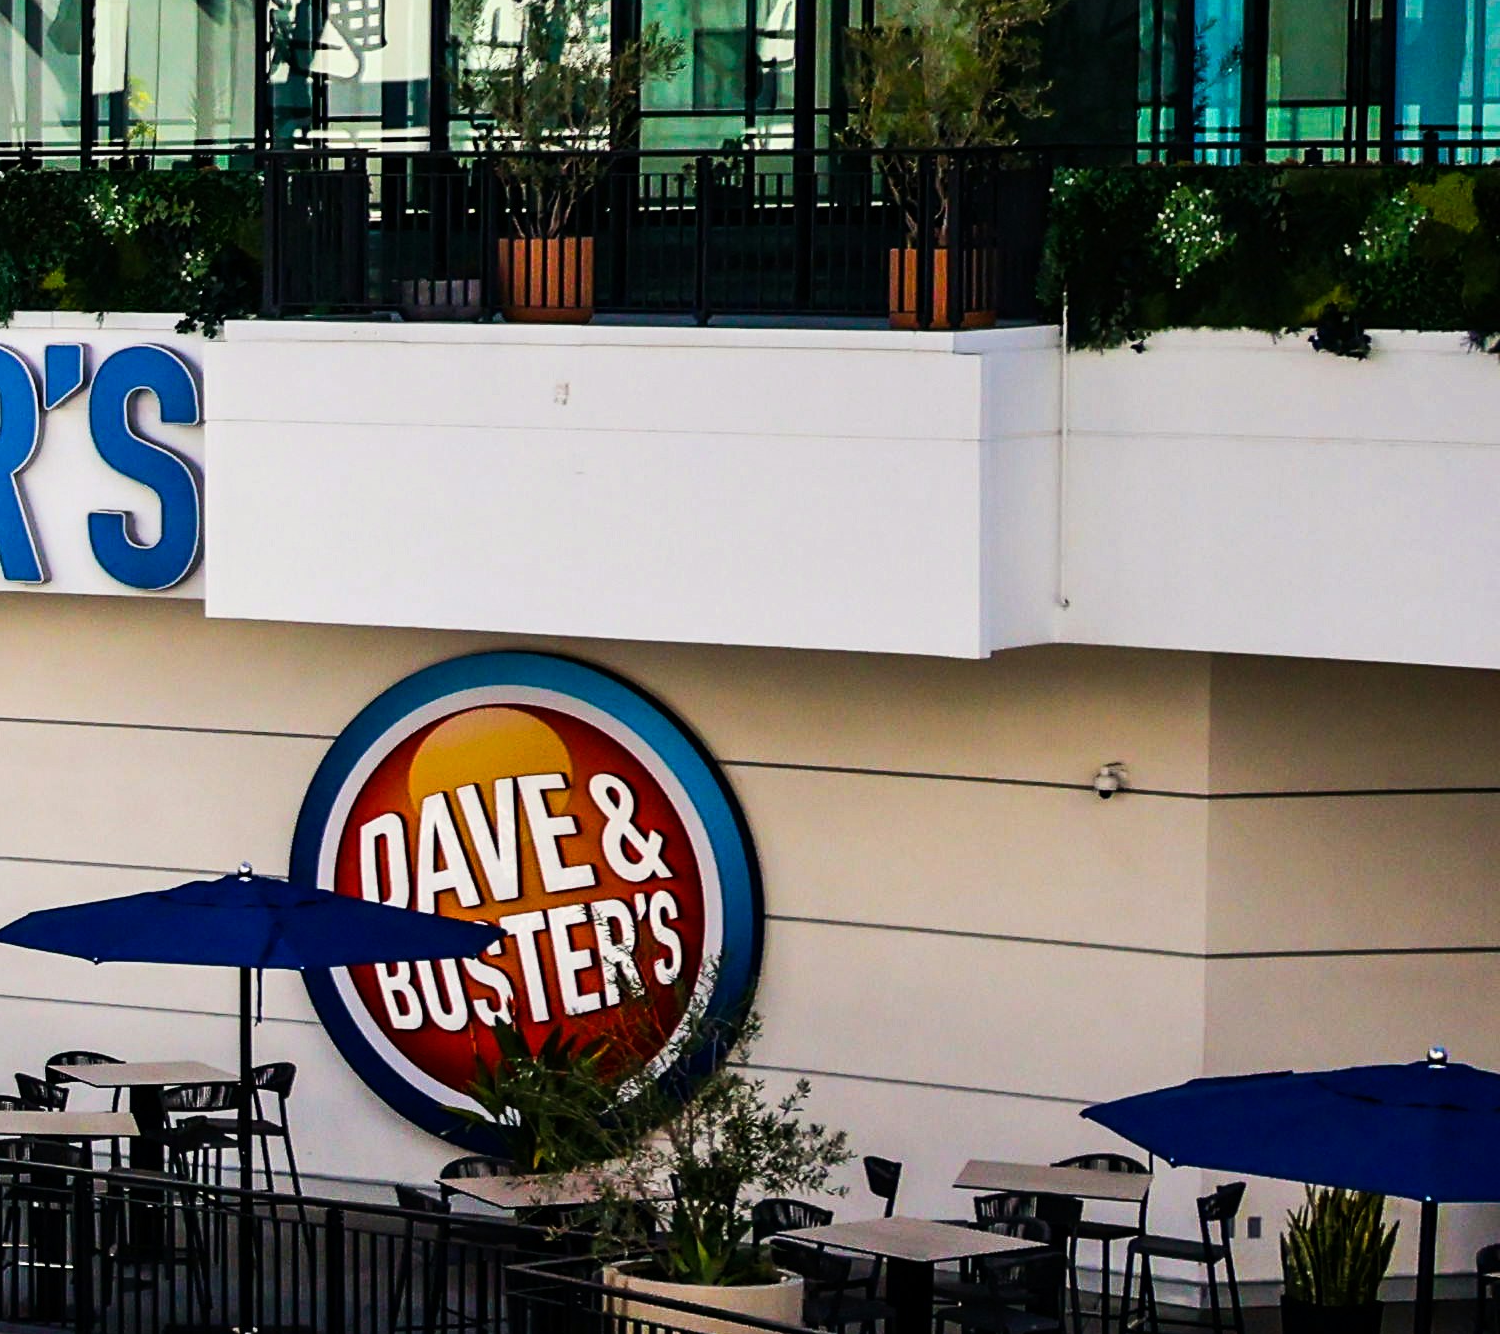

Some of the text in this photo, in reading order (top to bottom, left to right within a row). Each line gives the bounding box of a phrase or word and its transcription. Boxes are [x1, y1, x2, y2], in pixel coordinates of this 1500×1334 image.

[359, 771, 674, 917] DAVE &
[374, 889, 681, 1033] BUSTER'S
